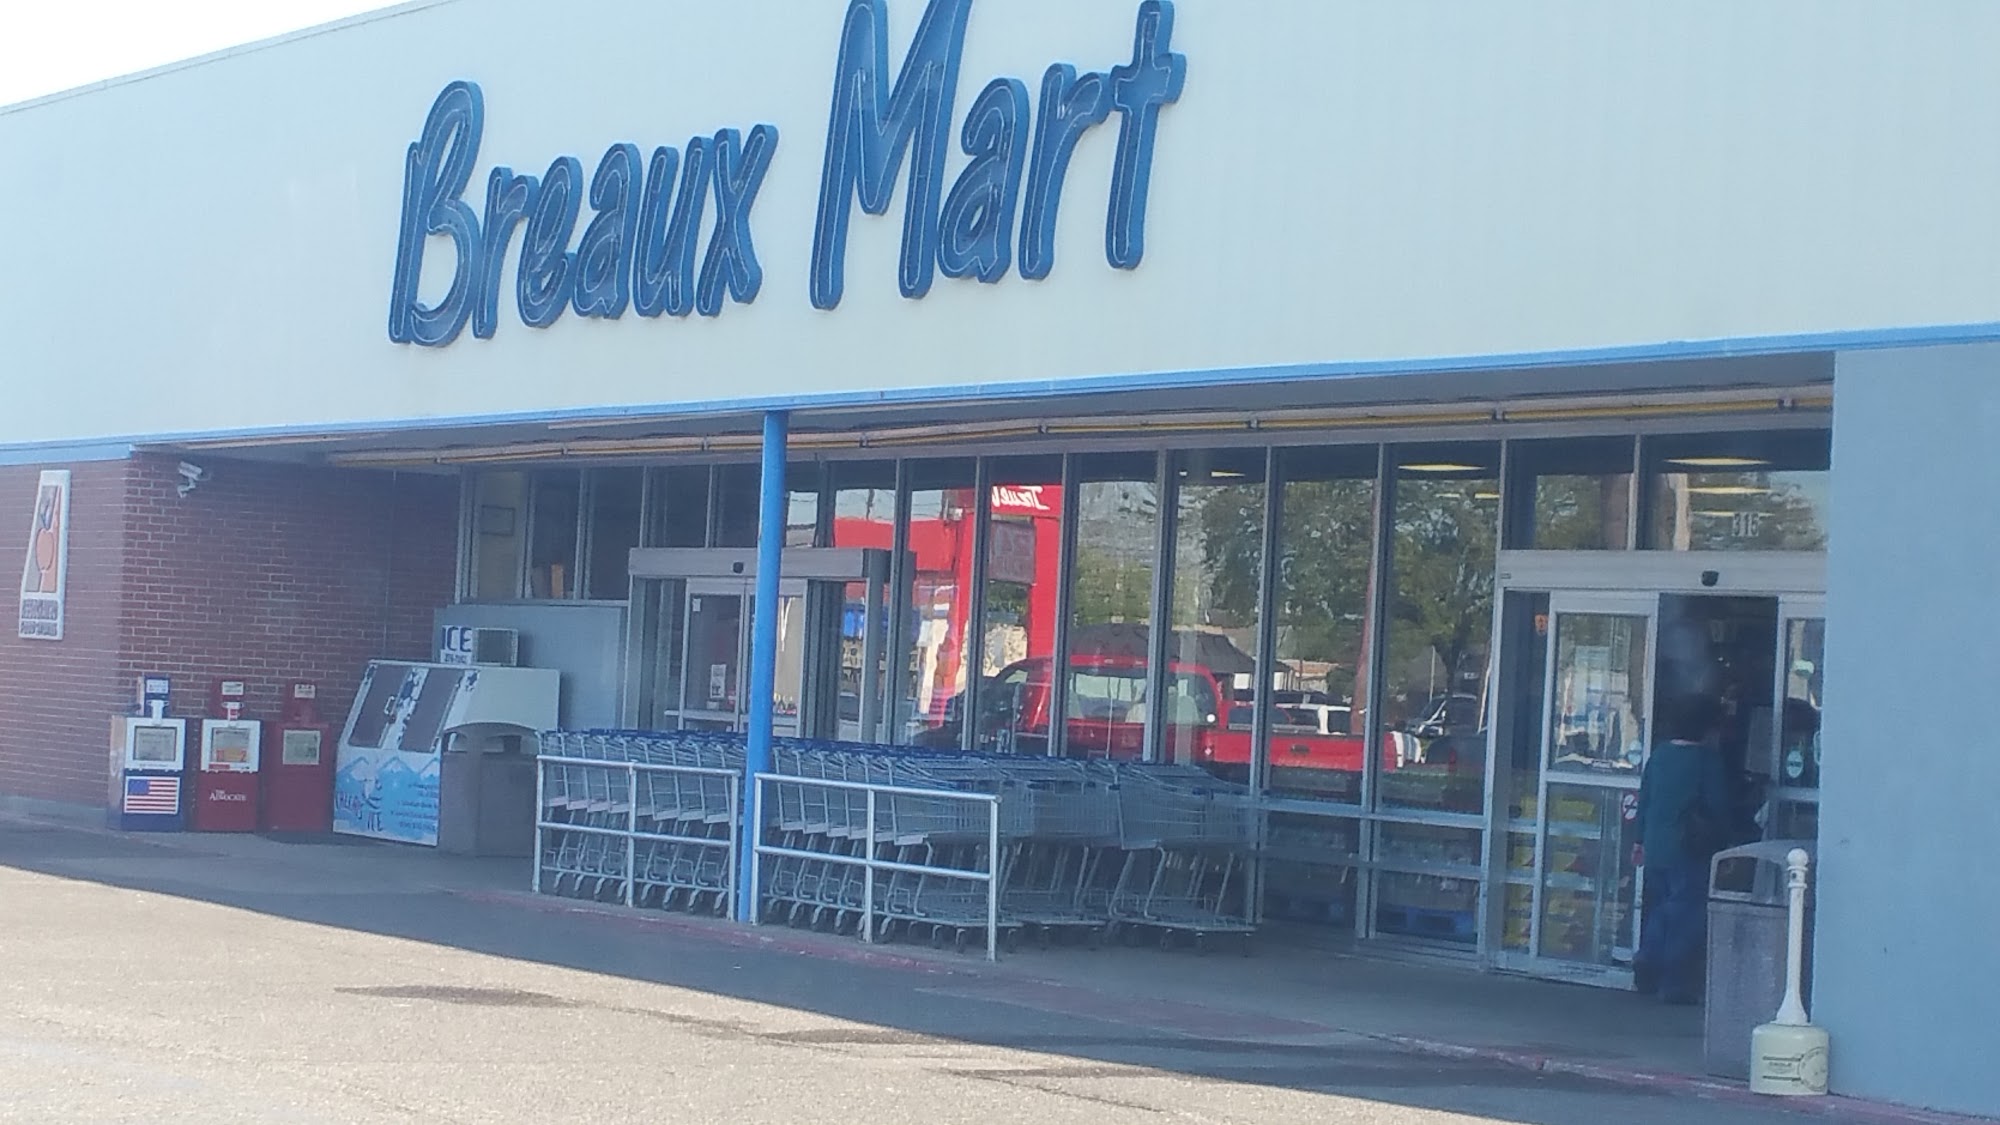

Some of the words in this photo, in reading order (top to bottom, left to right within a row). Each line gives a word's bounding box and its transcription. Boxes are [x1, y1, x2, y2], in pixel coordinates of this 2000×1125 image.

[388, 81, 778, 347] Breaux
[809, 0, 1187, 311] Mart
[441, 626, 472, 653] ICE
